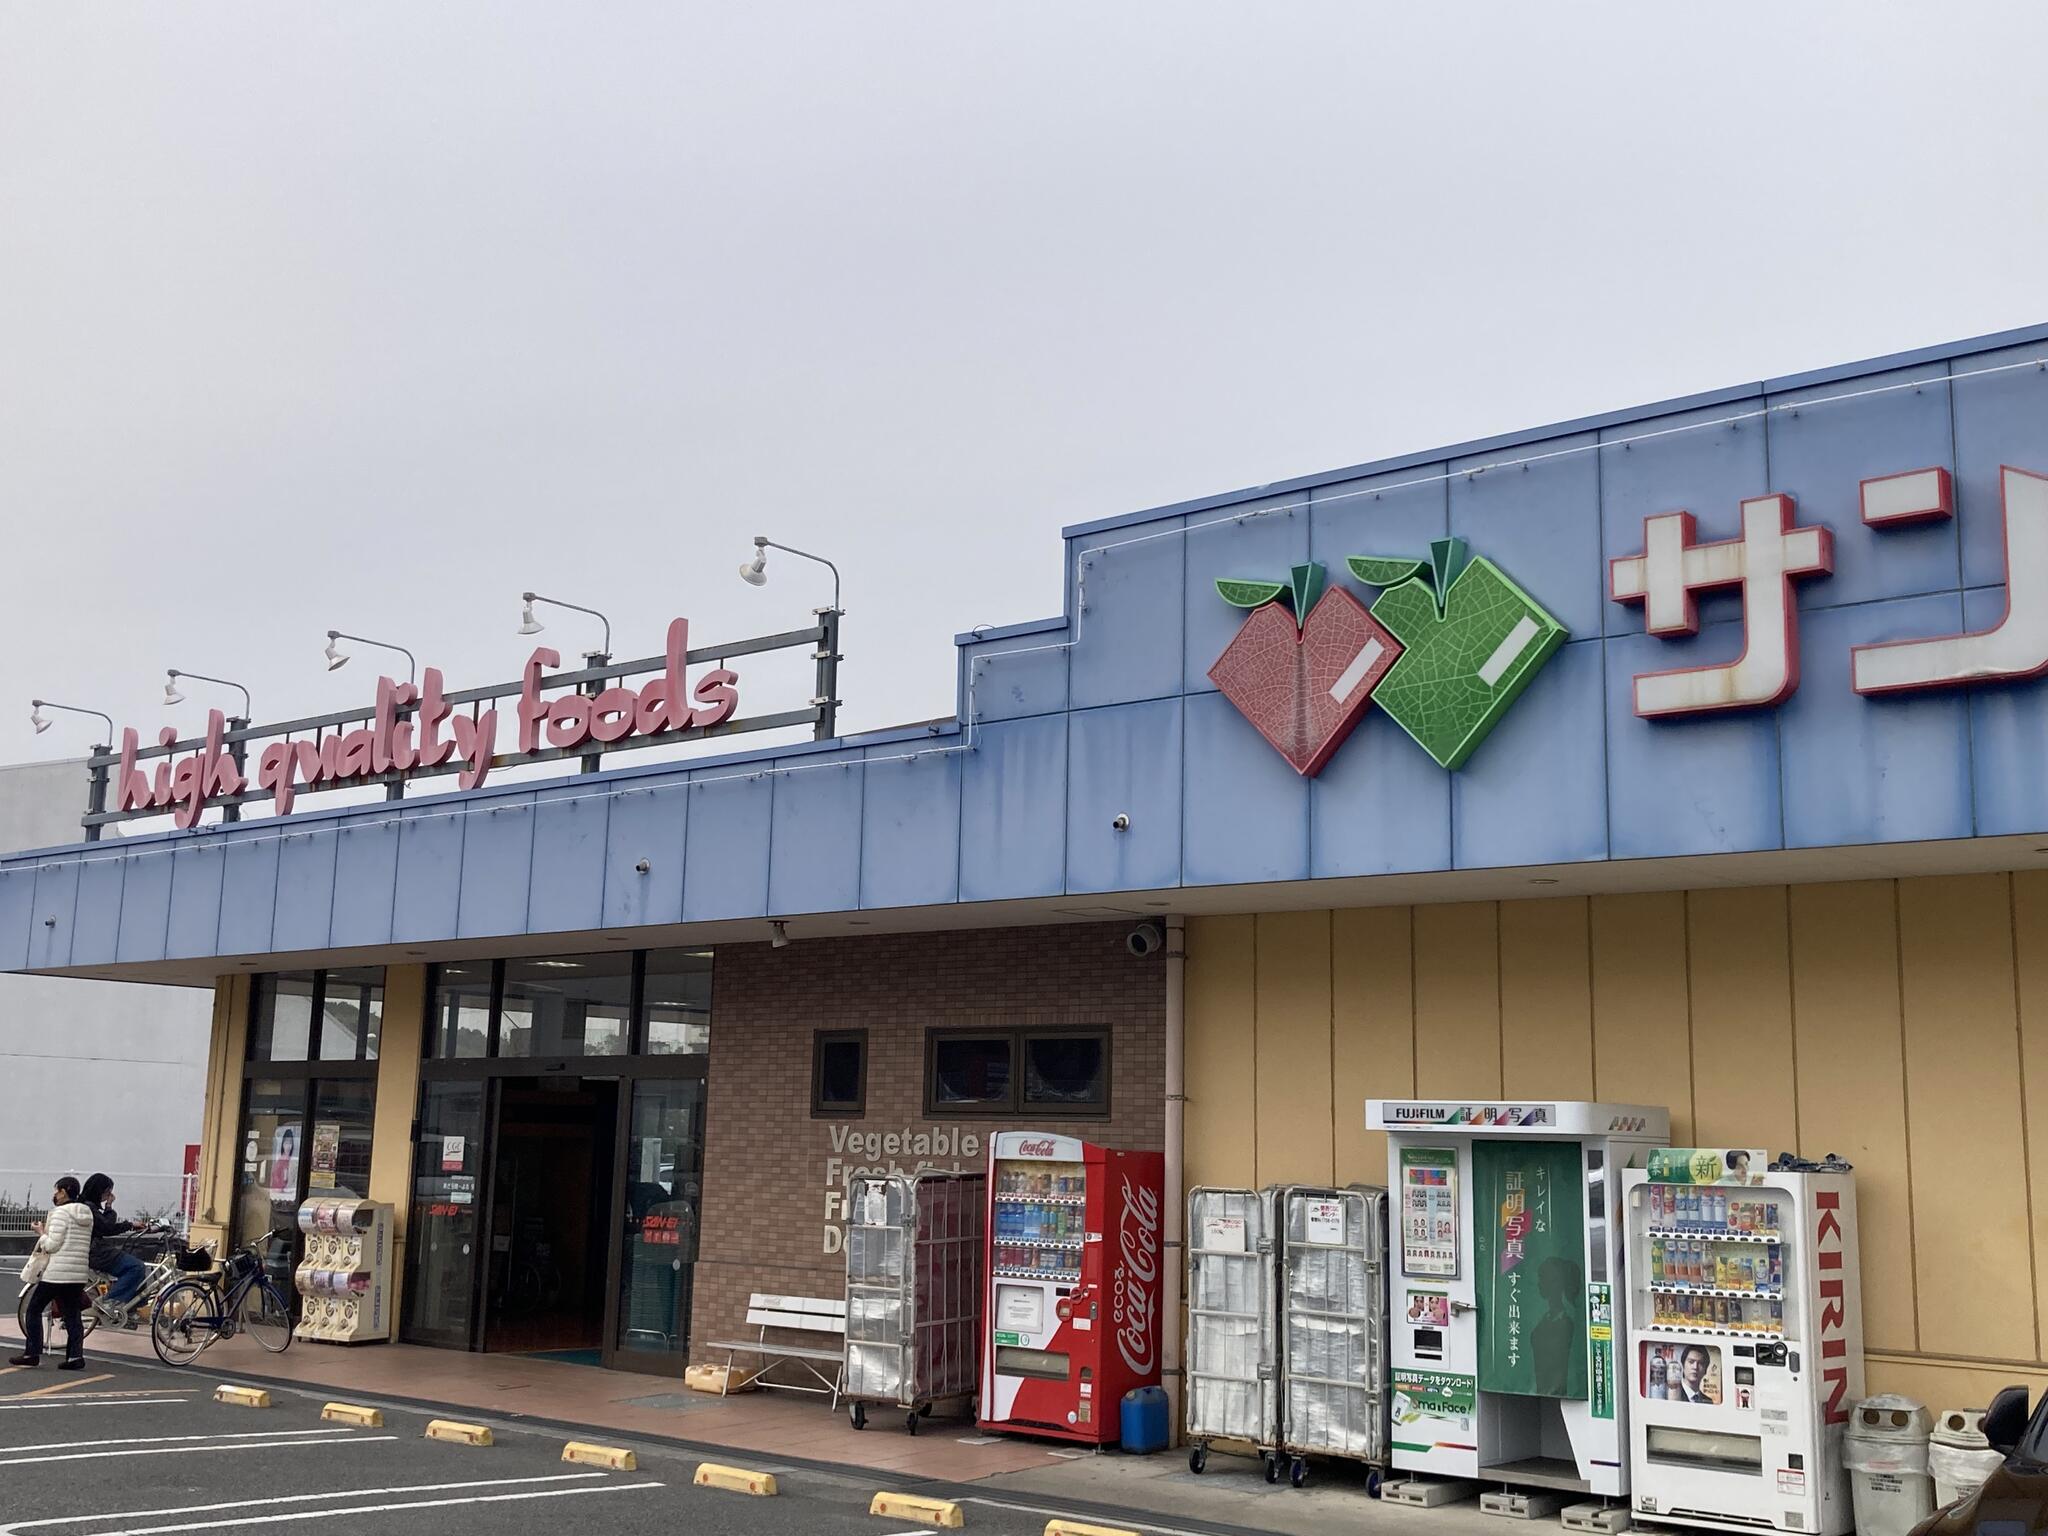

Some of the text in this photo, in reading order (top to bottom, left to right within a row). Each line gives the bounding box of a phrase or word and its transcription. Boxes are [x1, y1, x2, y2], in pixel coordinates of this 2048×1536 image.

[117, 617, 739, 829] high quality foods
[829, 1125, 980, 1162] Vegetable
[1395, 1106, 1548, 1123] FUJIFILM 証明写真
[1019, 1139, 1057, 1157] Coca-Cola
[1695, 1155, 1717, 1180] 新
[1535, 1167, 1546, 1232] キレイな
[1117, 1172, 1158, 1376] Coca-Cola
[1505, 1171, 1525, 1367] 証明写真 すぐ出来ます
[1816, 1192, 1849, 1425] KIRIN
